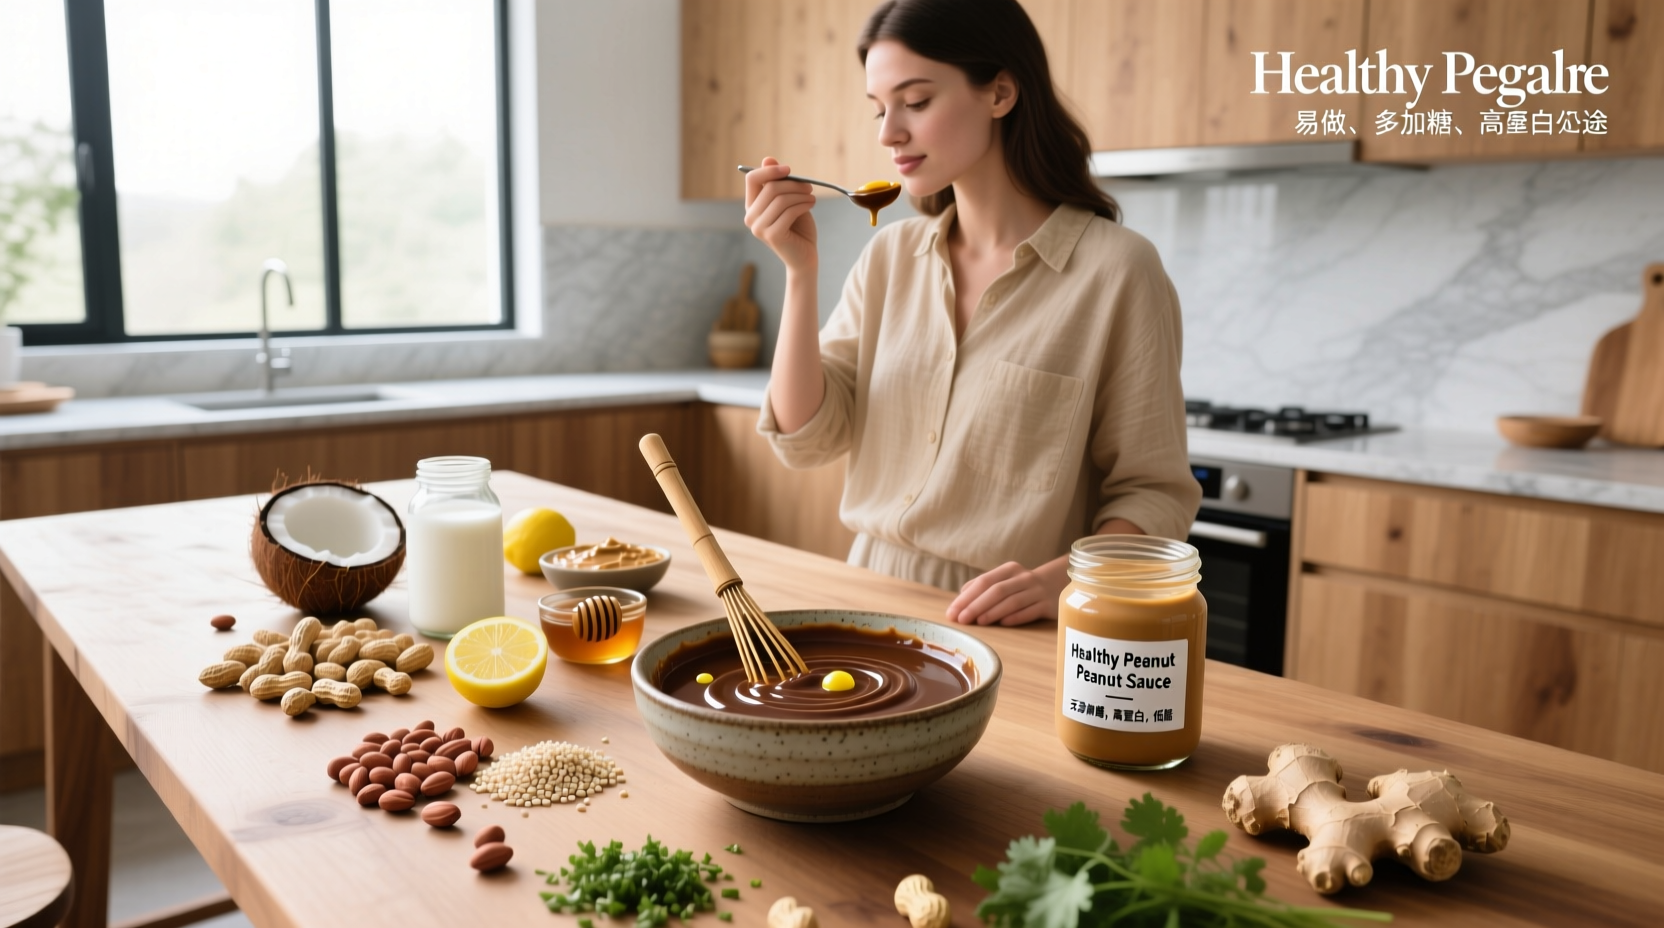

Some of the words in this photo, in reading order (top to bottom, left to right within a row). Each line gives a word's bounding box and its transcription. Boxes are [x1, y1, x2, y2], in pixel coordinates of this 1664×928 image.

[1124, 652, 1175, 668] Peanut
[1077, 664, 1122, 688] Peanut
[1126, 673, 1171, 689] Sauce
